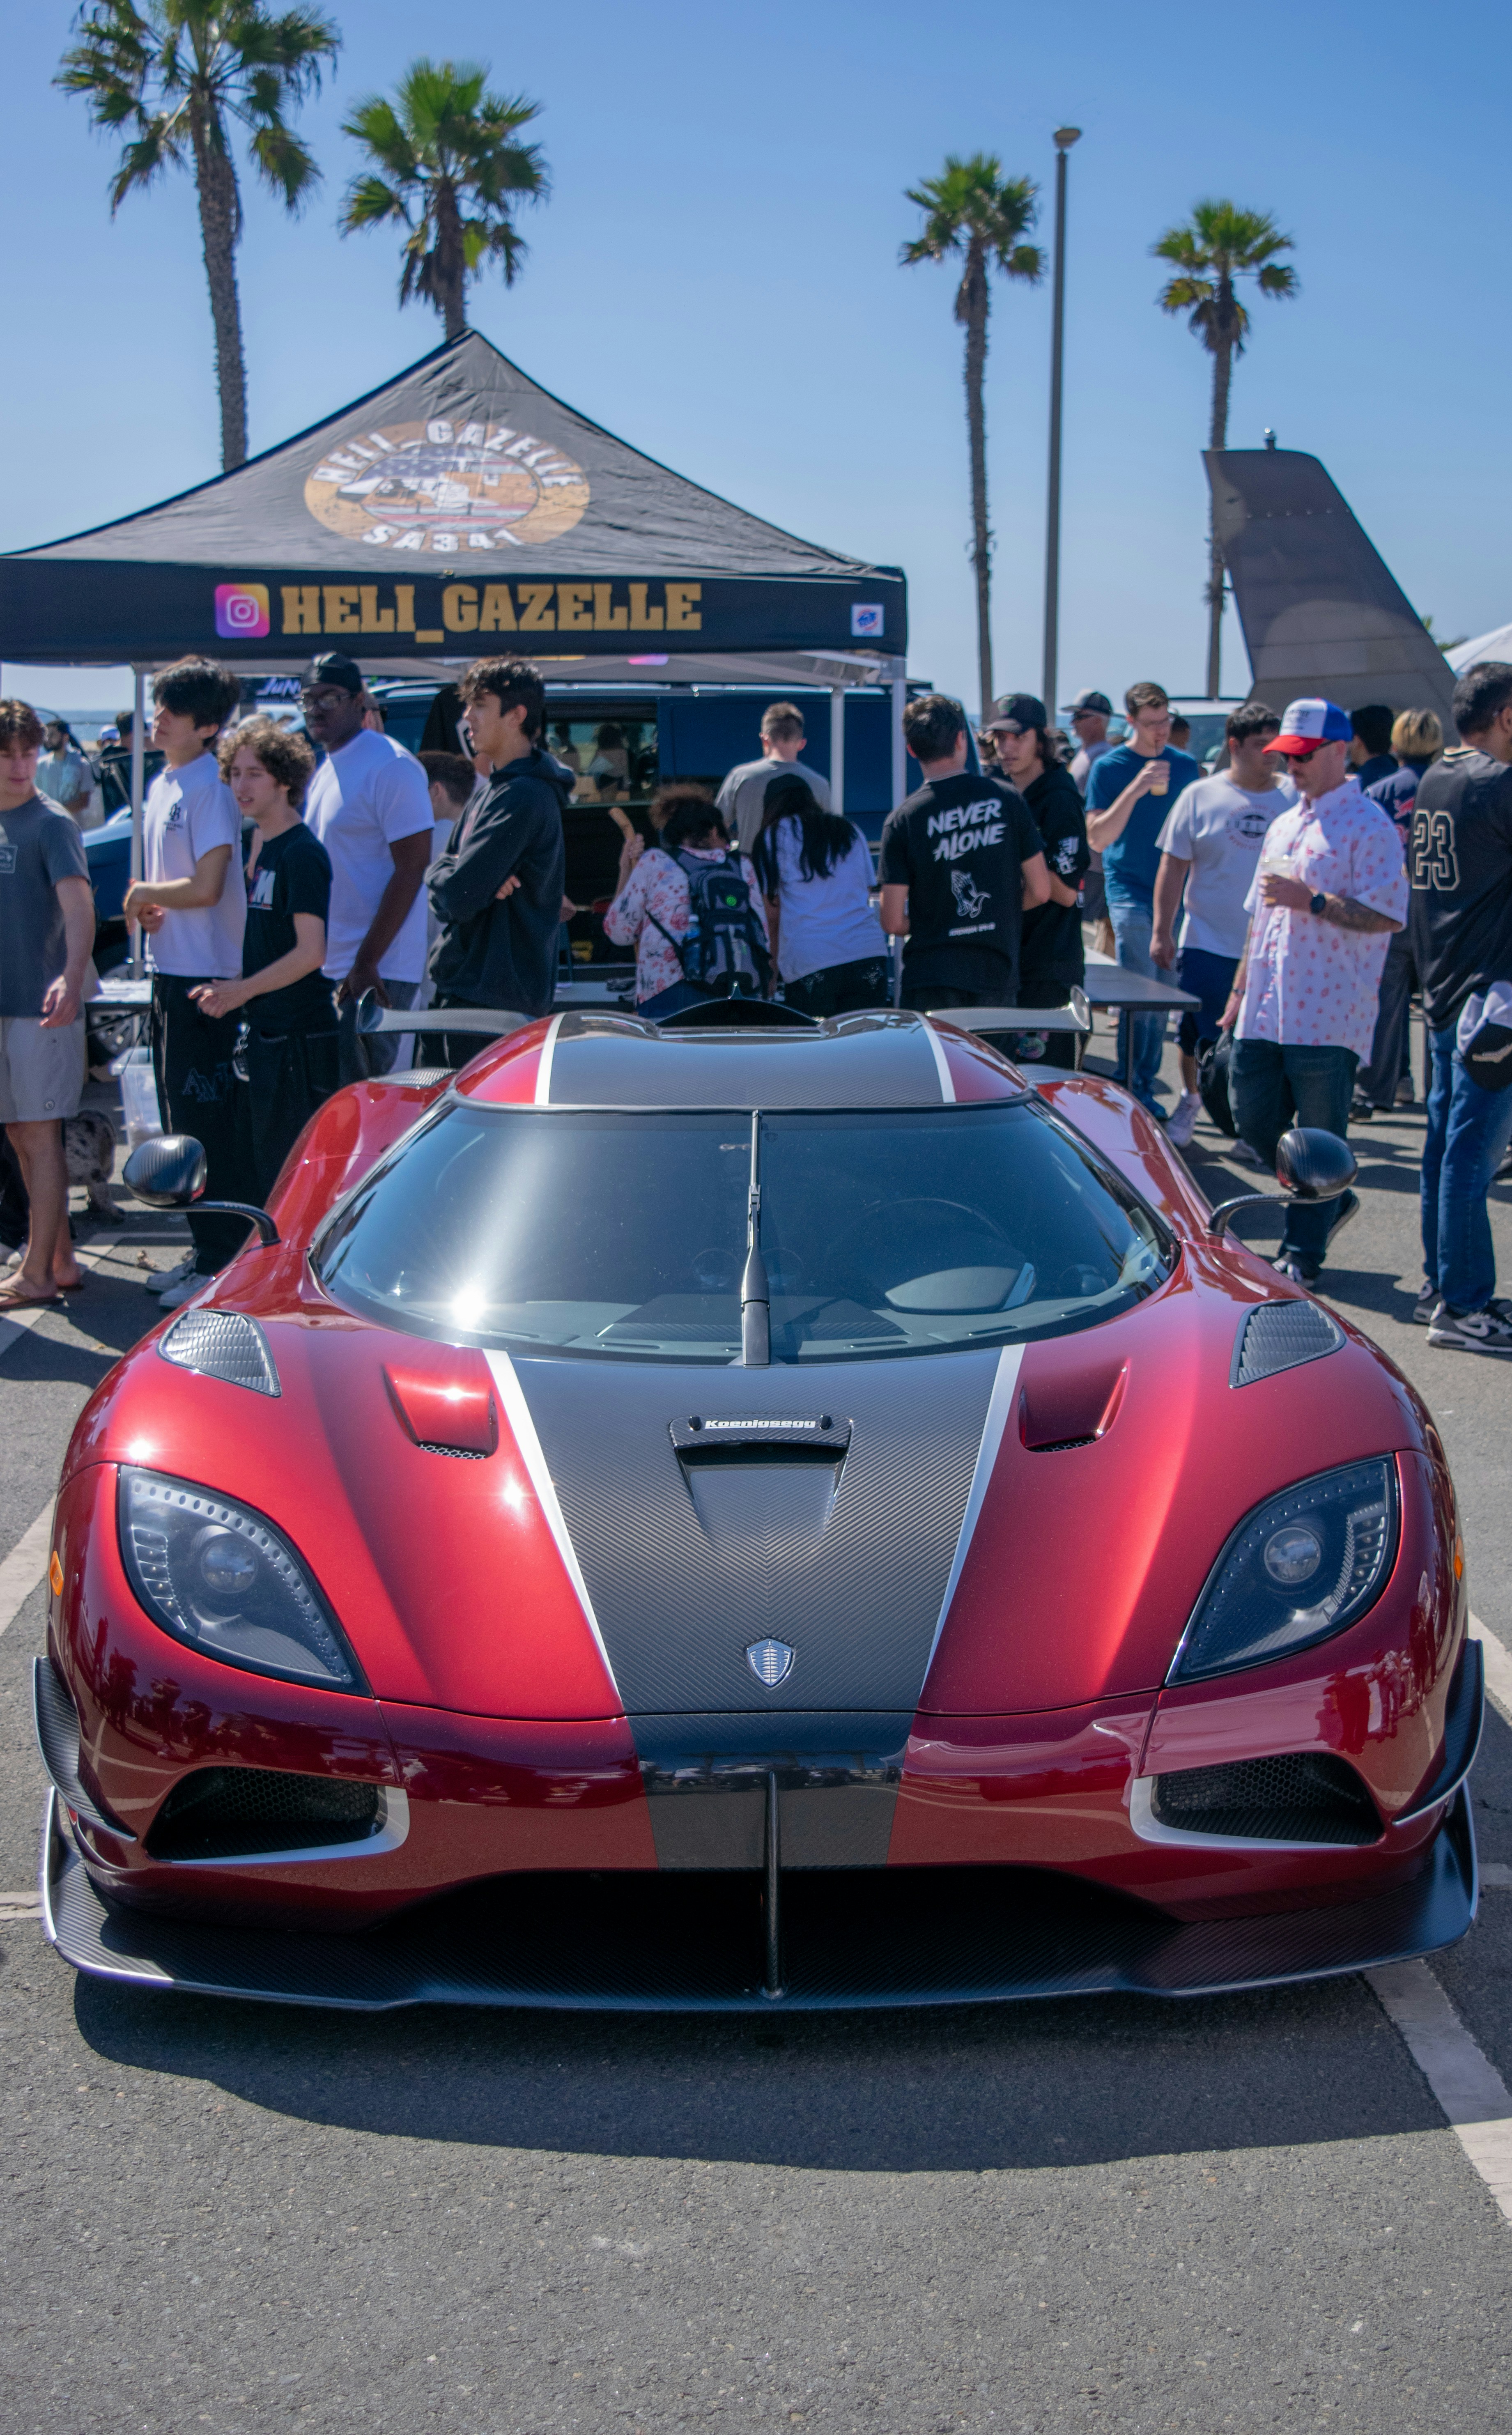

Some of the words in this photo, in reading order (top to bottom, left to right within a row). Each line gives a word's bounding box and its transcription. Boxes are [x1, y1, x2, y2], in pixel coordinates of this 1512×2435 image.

[280, 583, 702, 643] HELI_GAZELLE
[927, 798, 1002, 838] NEVER
[933, 822, 1007, 862] ALONE
[1411, 809, 1460, 891] 23
[705, 1420, 816, 1429] Koenigsegg
